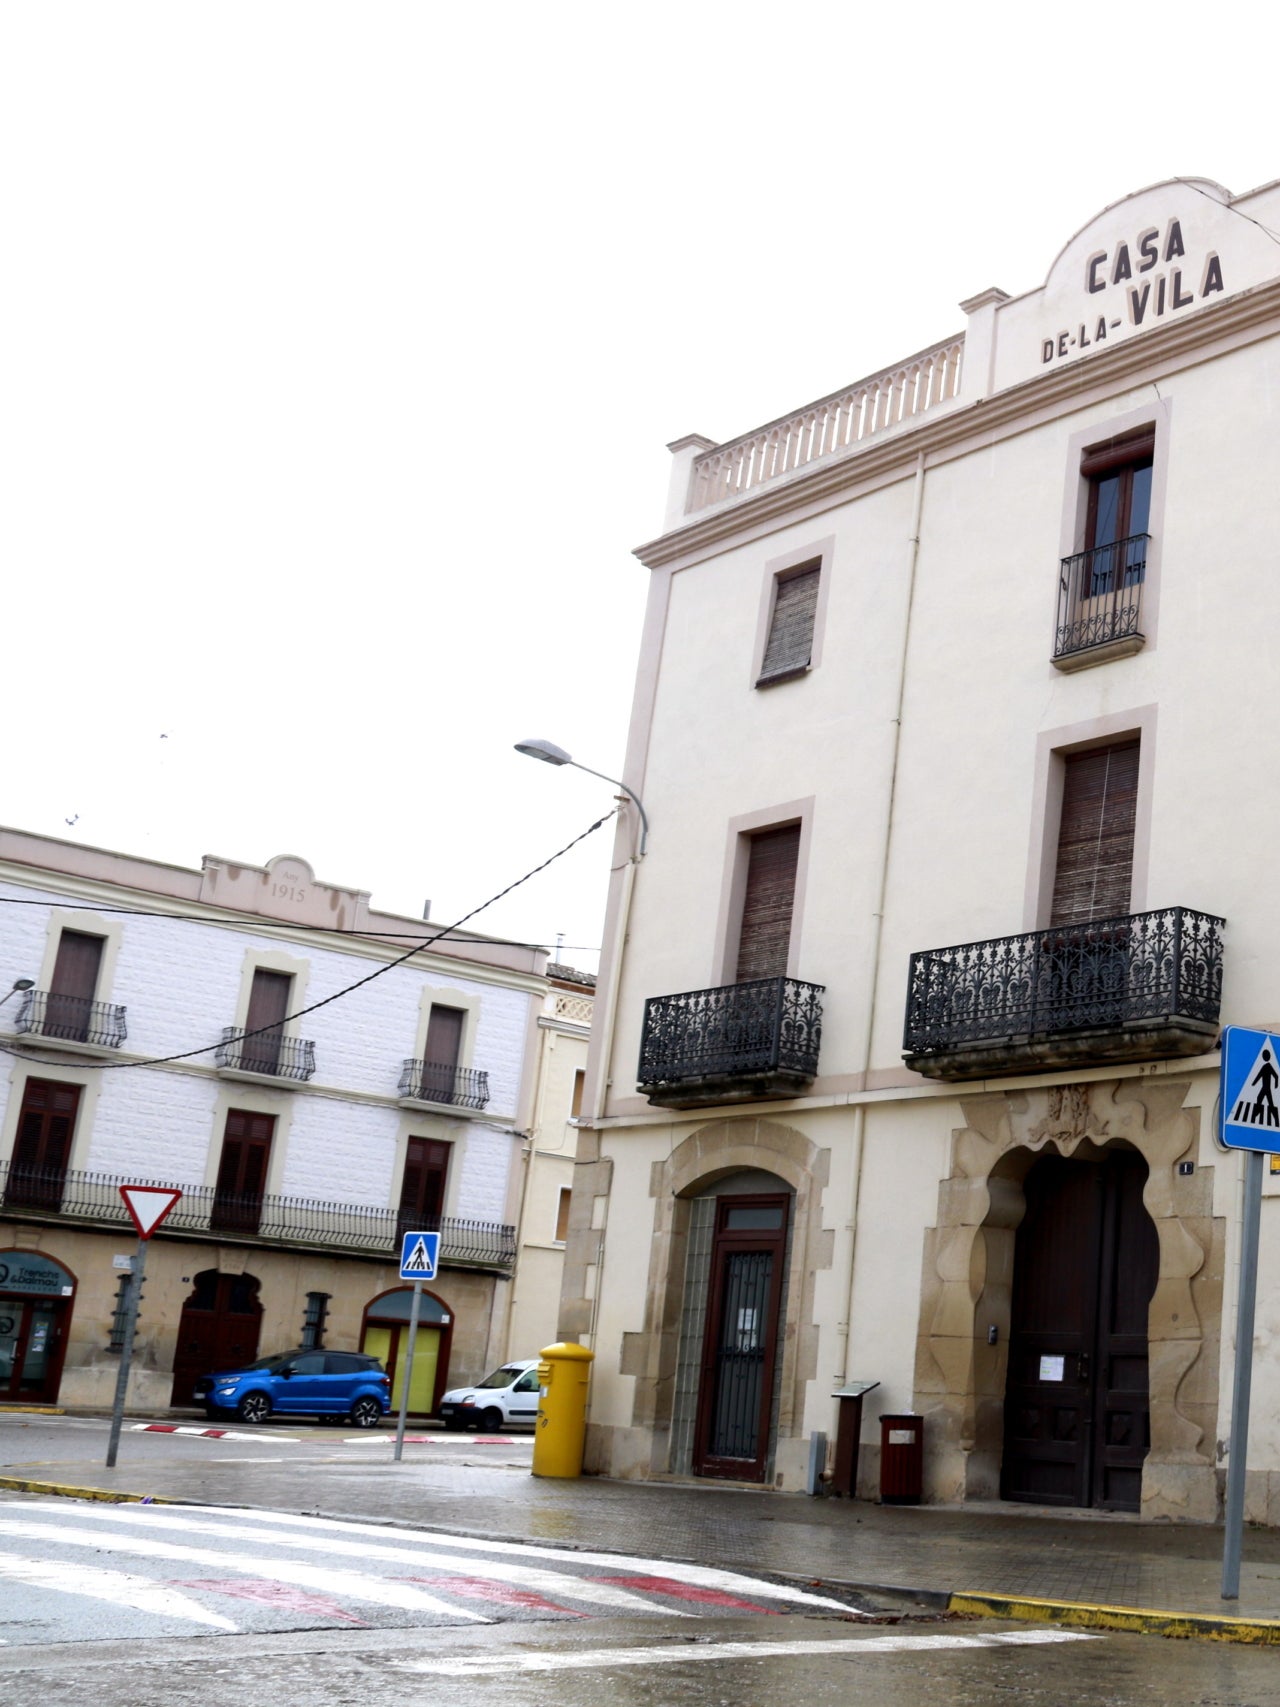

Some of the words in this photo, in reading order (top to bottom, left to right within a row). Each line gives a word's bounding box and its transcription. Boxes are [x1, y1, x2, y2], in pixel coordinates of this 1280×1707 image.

[1085, 217, 1185, 294] CASA
[1126, 250, 1224, 326] VILA
[271, 883, 306, 903] 1915
